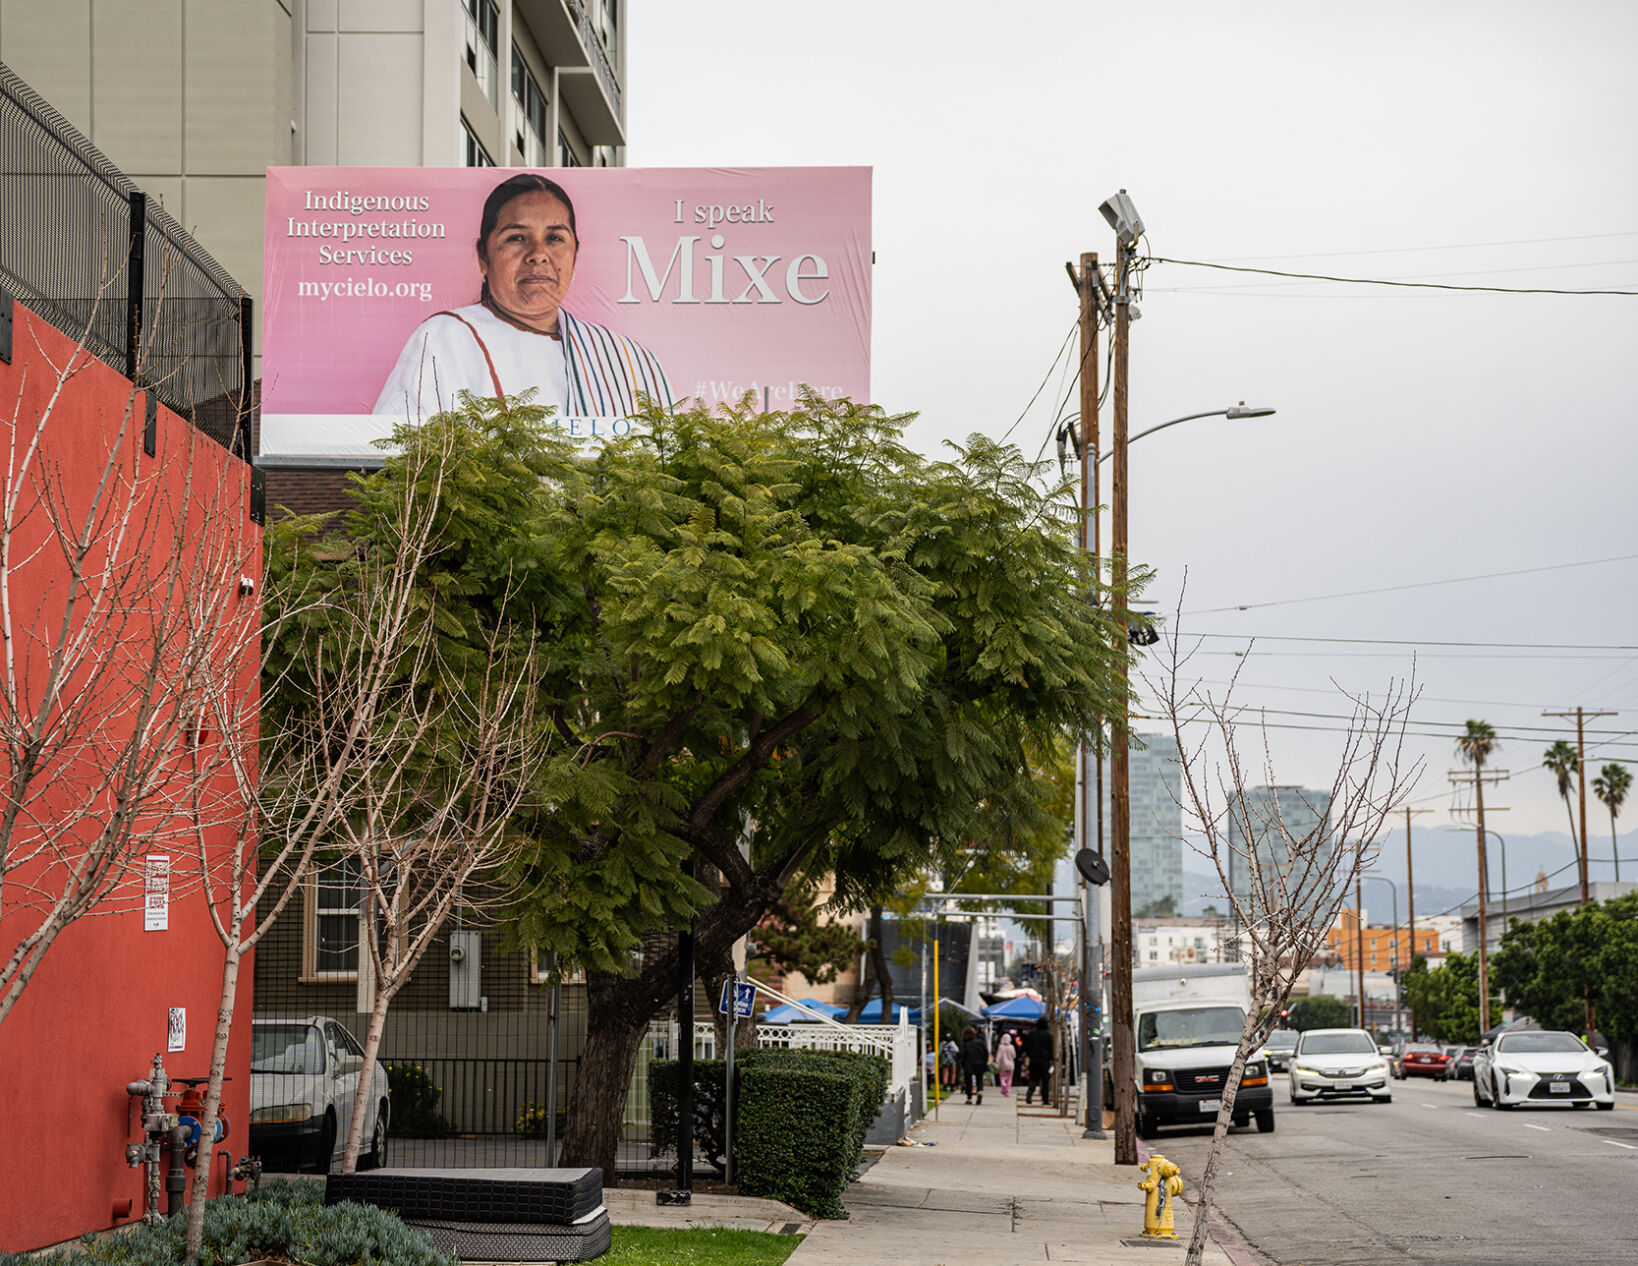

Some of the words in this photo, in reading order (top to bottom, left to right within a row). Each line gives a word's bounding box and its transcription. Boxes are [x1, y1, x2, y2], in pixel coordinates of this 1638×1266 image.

[304, 190, 430, 216] Indigenous
[673, 199, 685, 224] I
[694, 199, 776, 230] speak
[287, 217, 447, 243] Interpretation
[318, 244, 414, 266] Services
[617, 234, 831, 306] Mixe
[297, 276, 433, 302] mycielo.org
[552, 418, 631, 437] IELO
